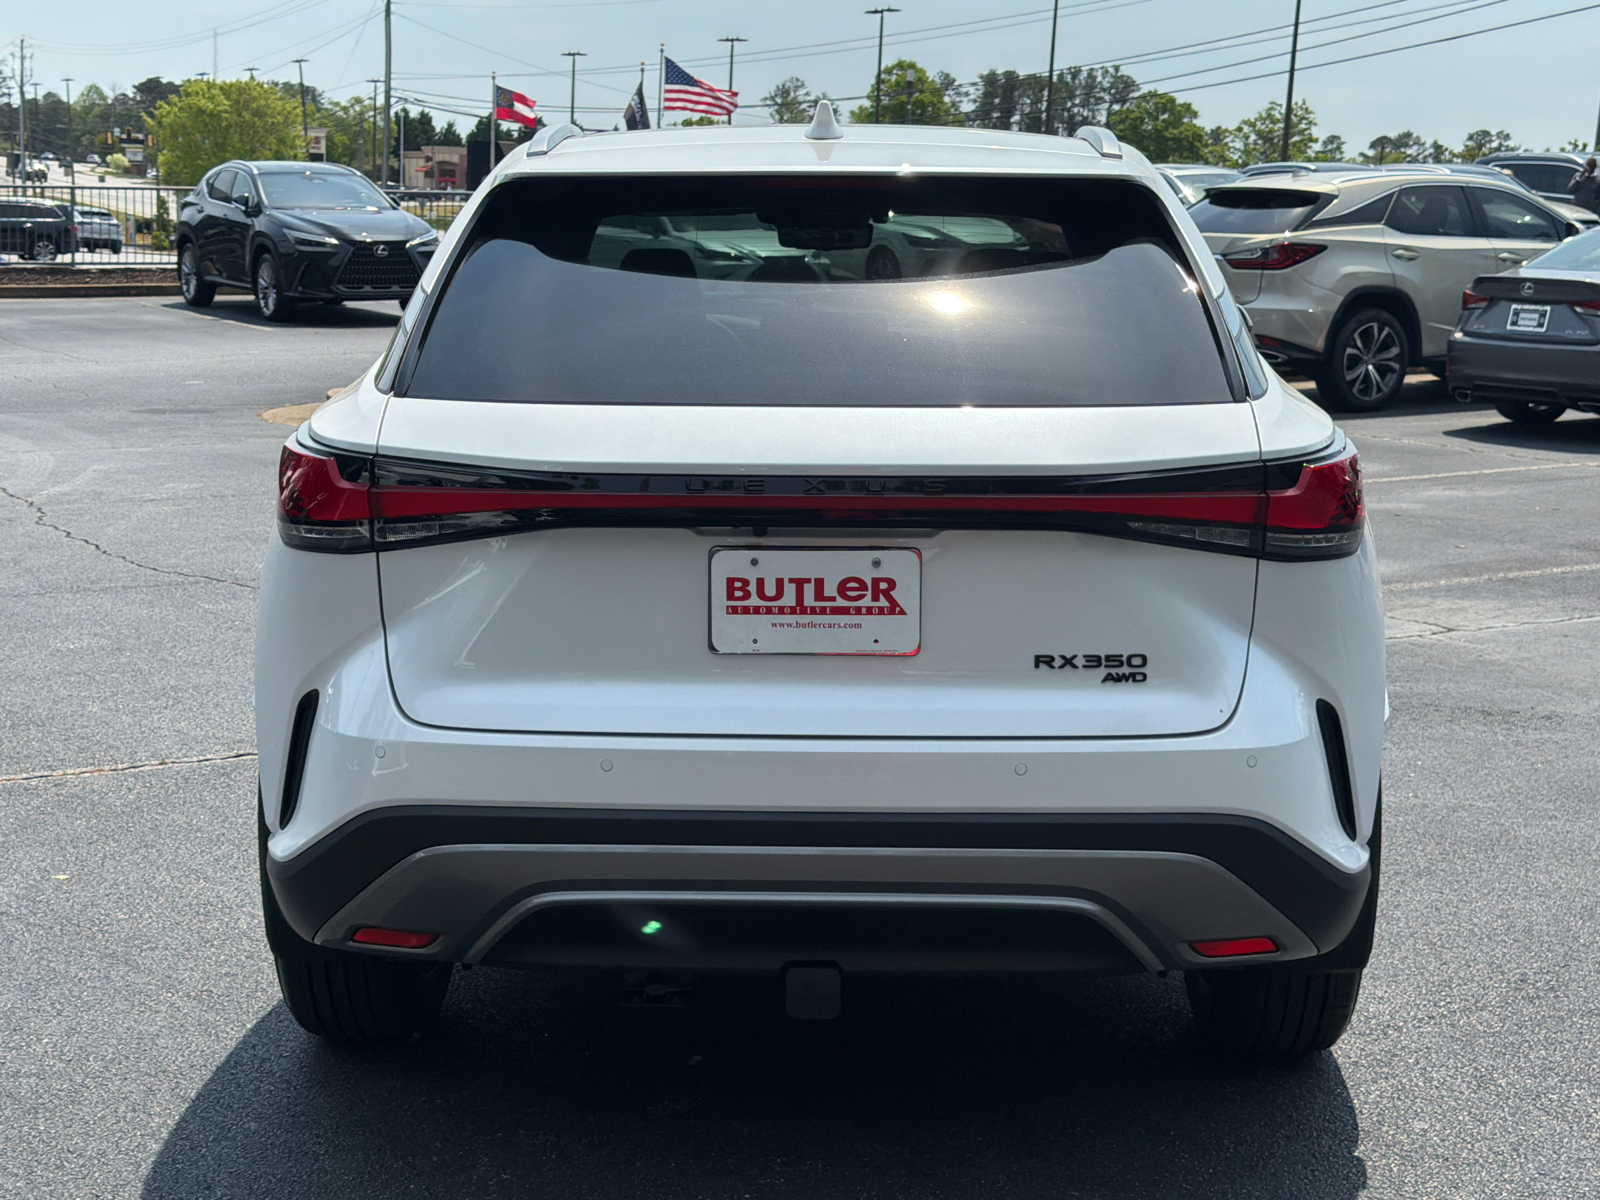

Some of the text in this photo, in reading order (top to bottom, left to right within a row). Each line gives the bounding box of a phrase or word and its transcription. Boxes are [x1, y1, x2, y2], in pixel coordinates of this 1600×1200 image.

[685, 478, 946, 493] LEXUS
[726, 606, 901, 615] AUTOMOTIVE GROUP
[771, 621, 863, 630] www.butlercars.com
[1101, 671, 1147, 683] AWD
